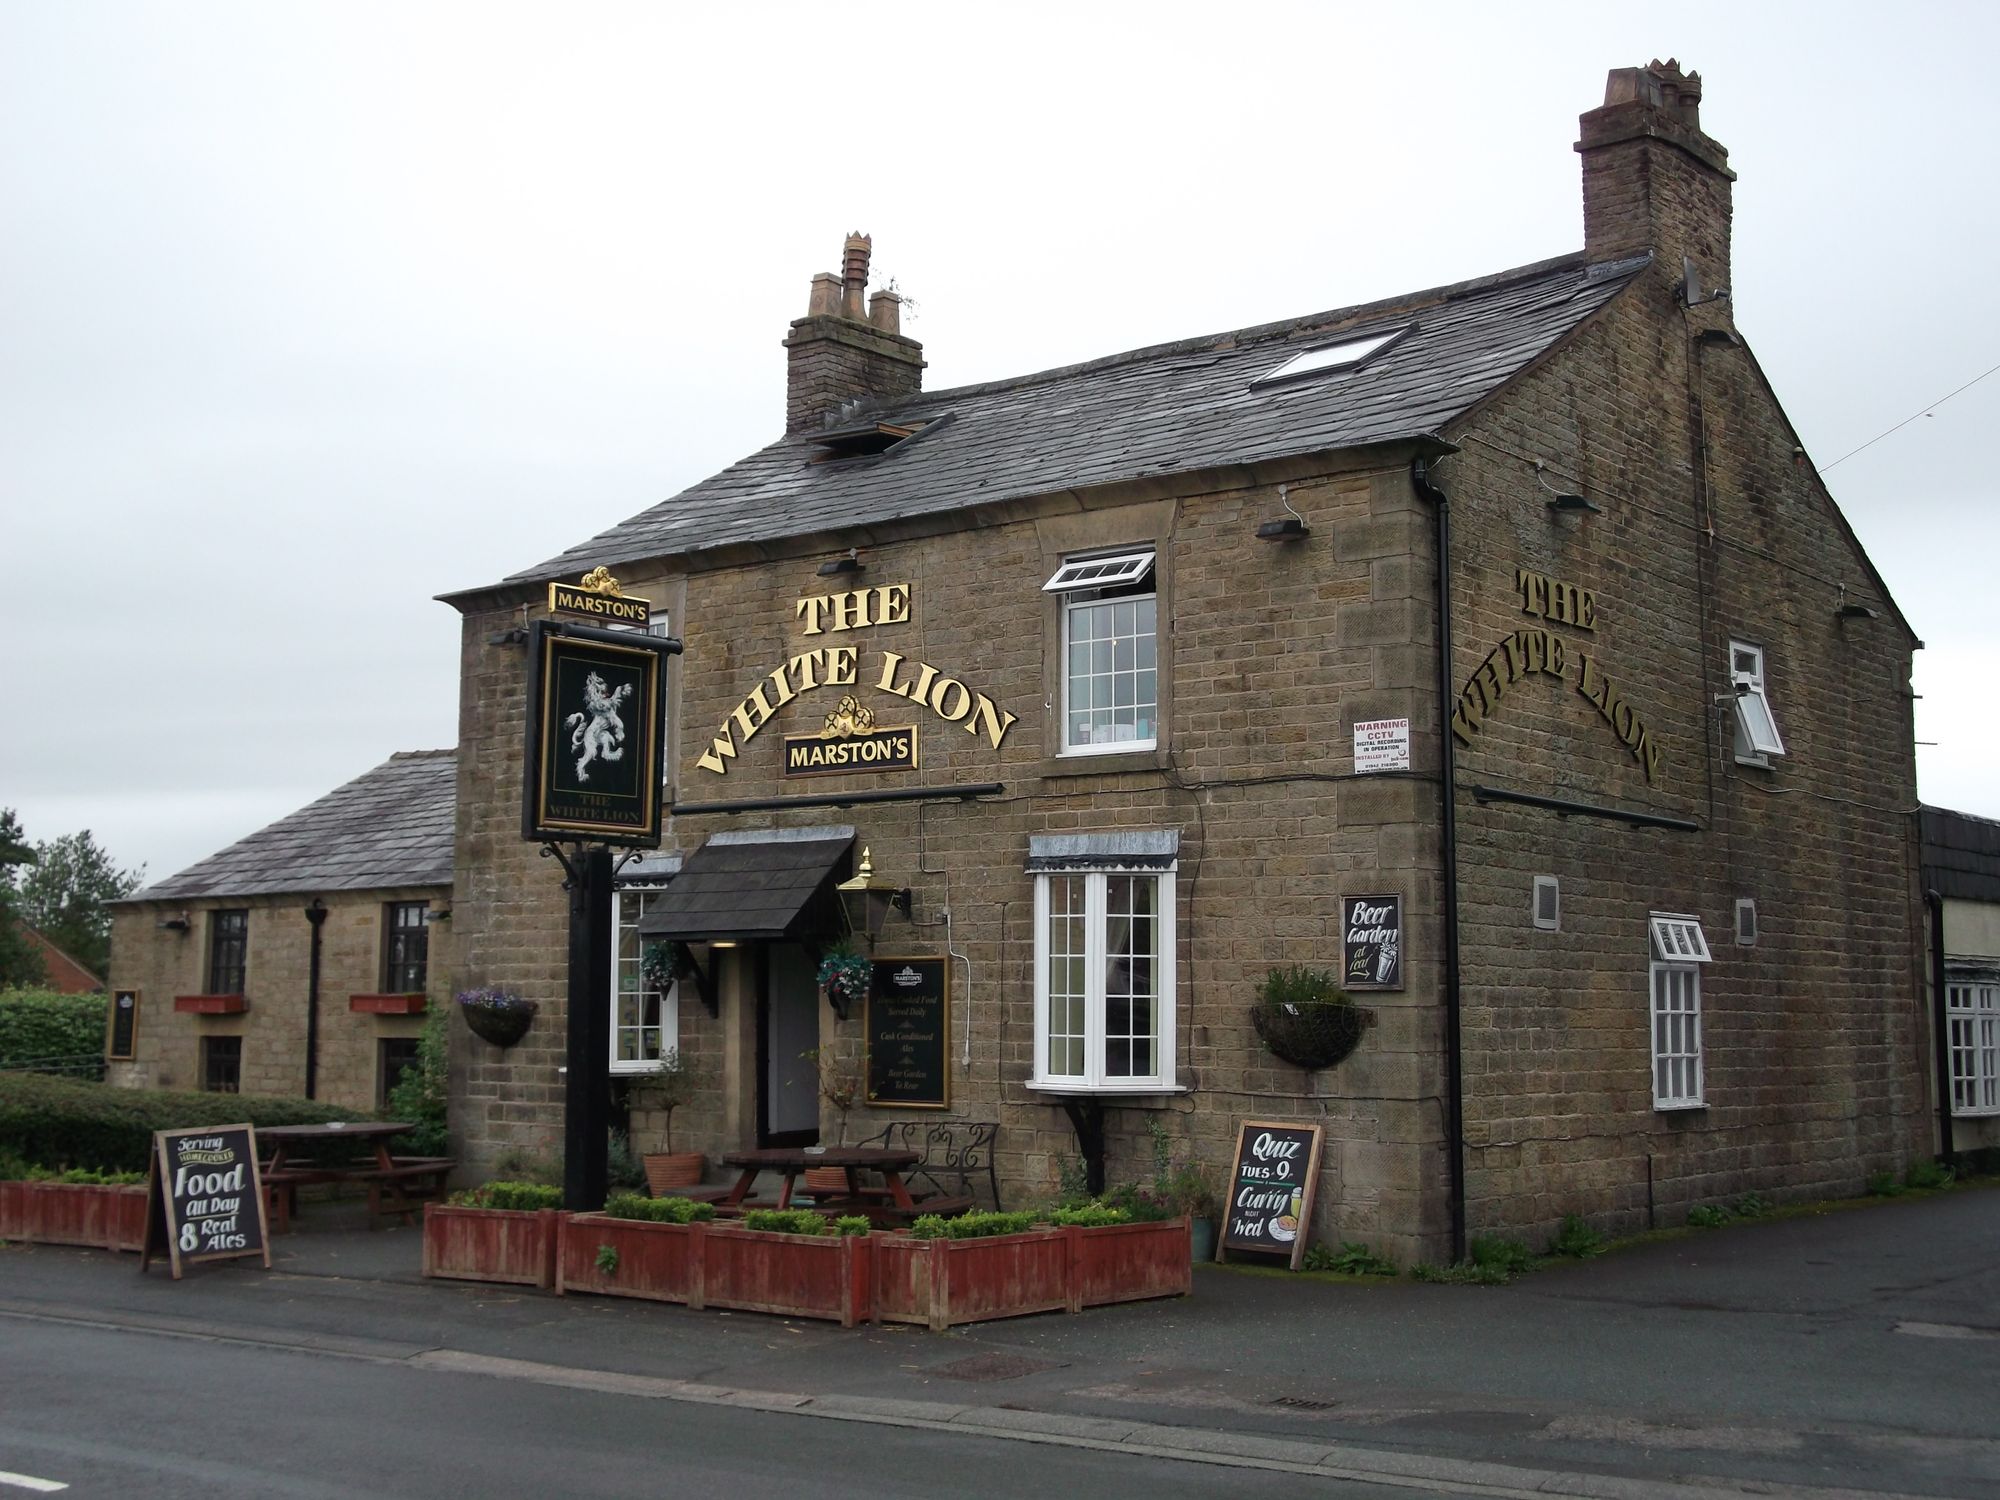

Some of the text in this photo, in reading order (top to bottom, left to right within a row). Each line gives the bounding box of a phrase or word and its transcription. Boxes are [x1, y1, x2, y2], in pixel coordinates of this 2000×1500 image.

[558, 592, 646, 620] MARSTON'S
[1515, 569, 1596, 630] THE
[798, 584, 911, 635] THE
[696, 646, 1017, 774] WHITE LION
[1452, 630, 1665, 782] WHITE LION
[1355, 720, 1407, 731] WARNING
[1367, 731, 1394, 740] CCTV
[790, 737, 909, 768] MARSTON'S
[579, 794, 611, 806] THE
[550, 805, 640, 822] WHITE LION
[1350, 901, 1394, 926] Beer
[1347, 925, 1398, 943] Garden
[1354, 946, 1368, 958] at
[921, 995, 937, 1004] Food
[909, 1008, 926, 1018] Daily
[880, 1032, 895, 1041] Cask
[178, 1136, 223, 1152] Serving
[1252, 1132, 1302, 1161] Quiz
[1241, 1161, 1290, 1180] TUES 9
[174, 1163, 246, 1198] Food
[210, 1197, 240, 1214] Day
[1237, 1186, 1289, 1217] Curry
[179, 1216, 236, 1252] 8 Real
[1234, 1217, 1263, 1237] Wed
[205, 1233, 246, 1250] Ales
